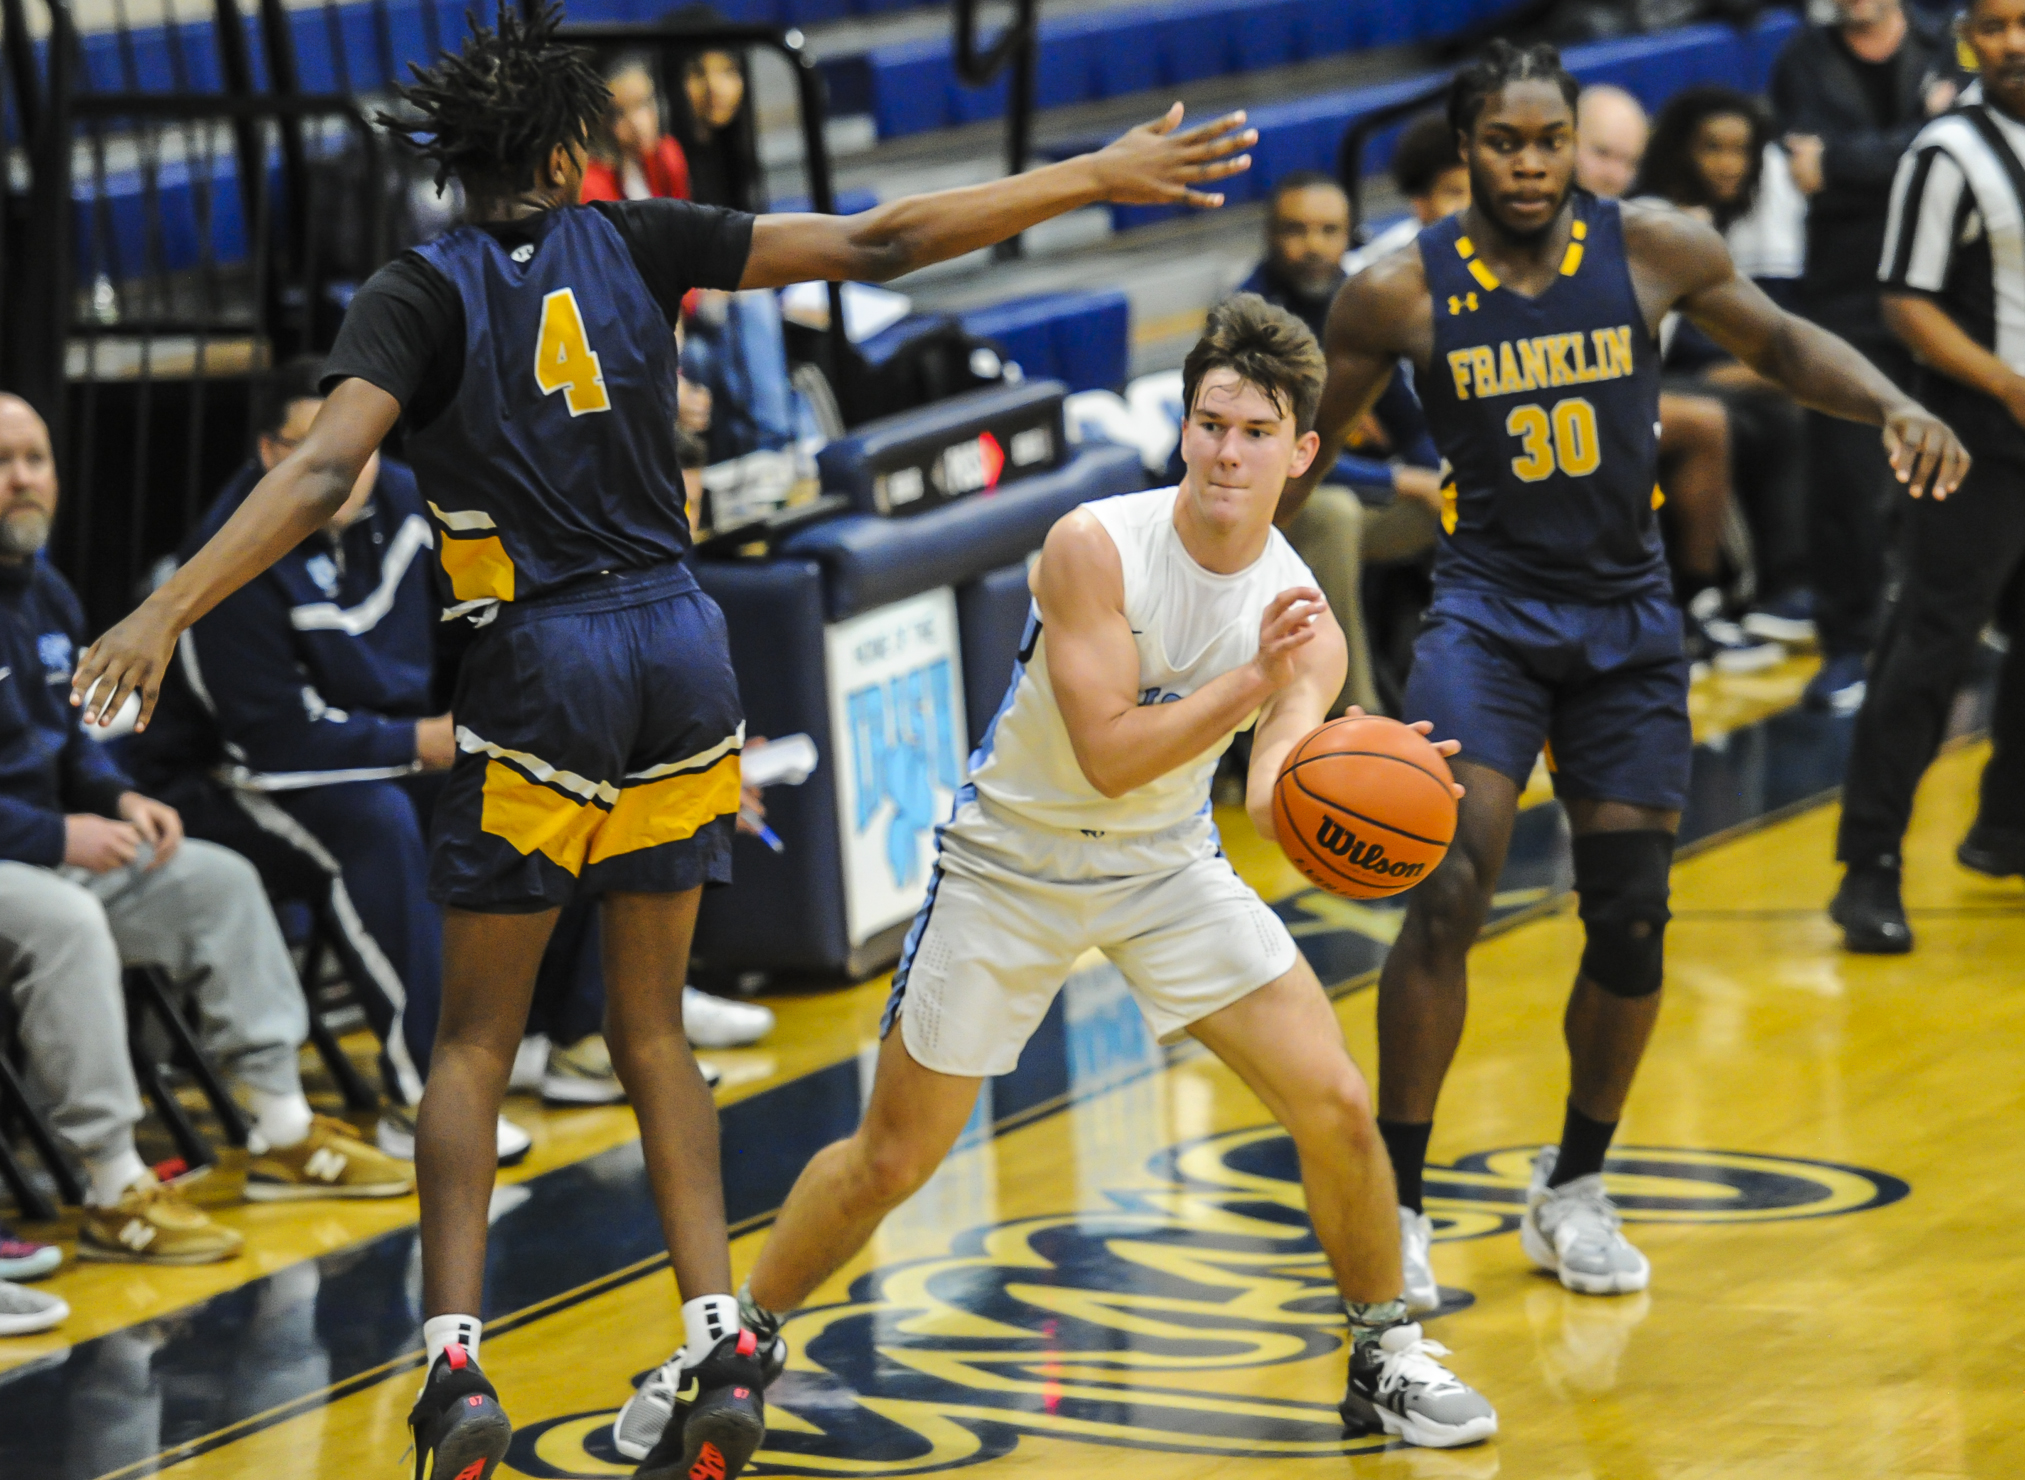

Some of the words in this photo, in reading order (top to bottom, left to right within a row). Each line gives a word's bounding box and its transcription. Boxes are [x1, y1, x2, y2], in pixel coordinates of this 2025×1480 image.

[534, 287, 611, 417] 4
[1447, 325, 1634, 400] FRANKLIN
[1506, 397, 1601, 482] 30
[1316, 814, 1426, 878] Wilson
